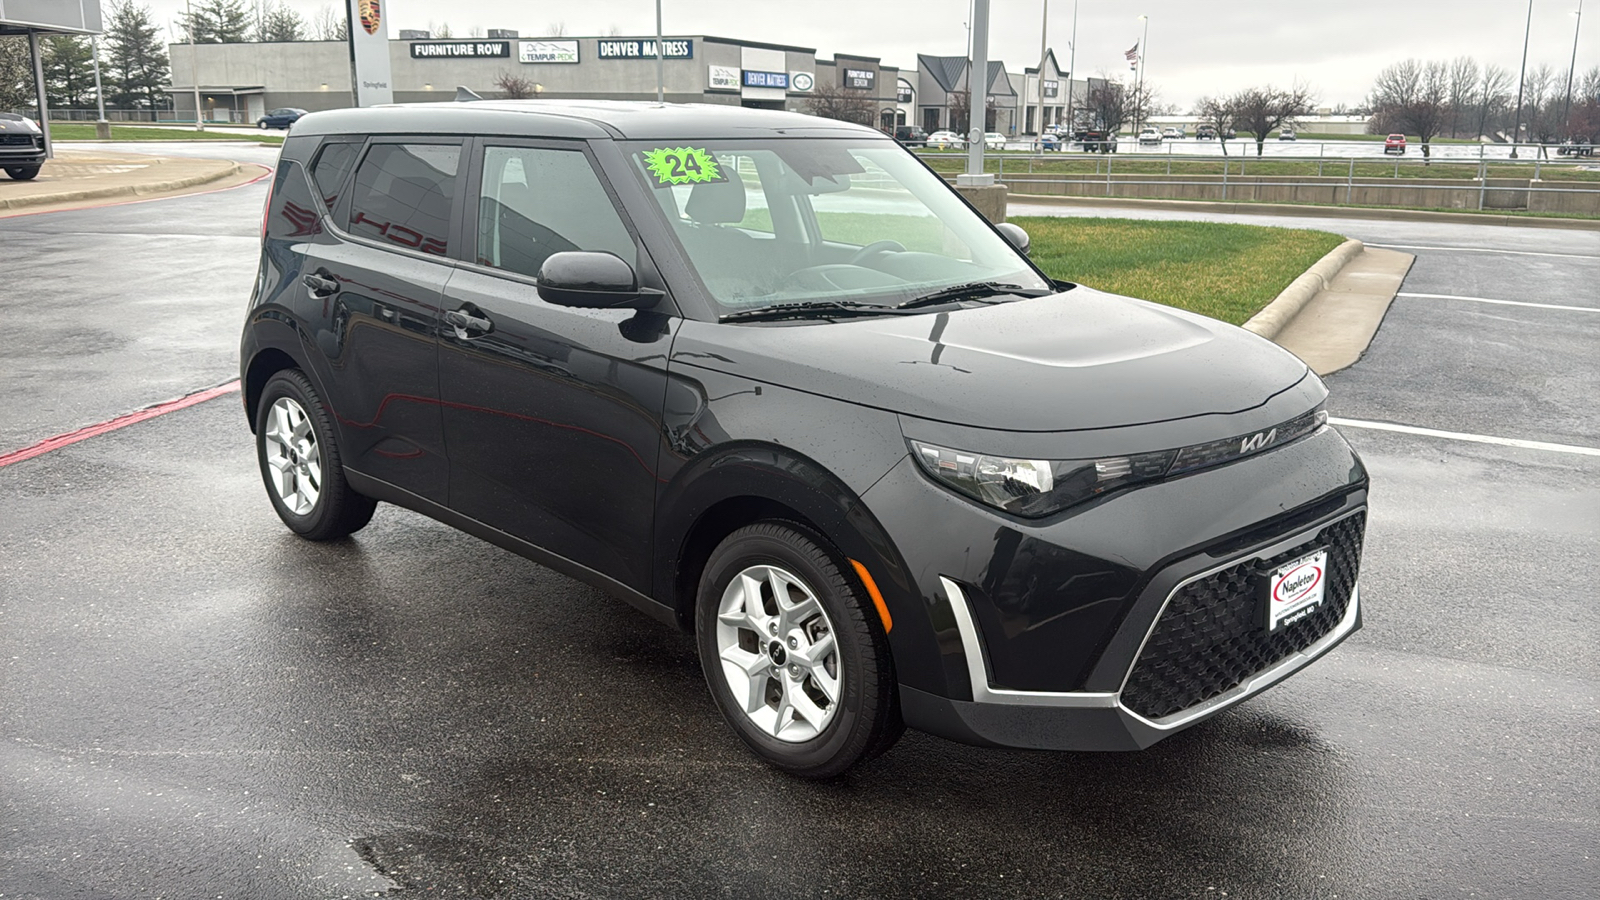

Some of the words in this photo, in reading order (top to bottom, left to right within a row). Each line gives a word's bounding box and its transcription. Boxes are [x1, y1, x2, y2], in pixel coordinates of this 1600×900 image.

[414, 44, 475, 56] FURNITURE
[476, 43, 502, 55] ROW
[600, 42, 639, 56] DENVER
[642, 41, 689, 56] MATRESS
[664, 153, 702, 177] 24
[1240, 427, 1277, 454] KIA
[1282, 573, 1315, 596] Napleton
